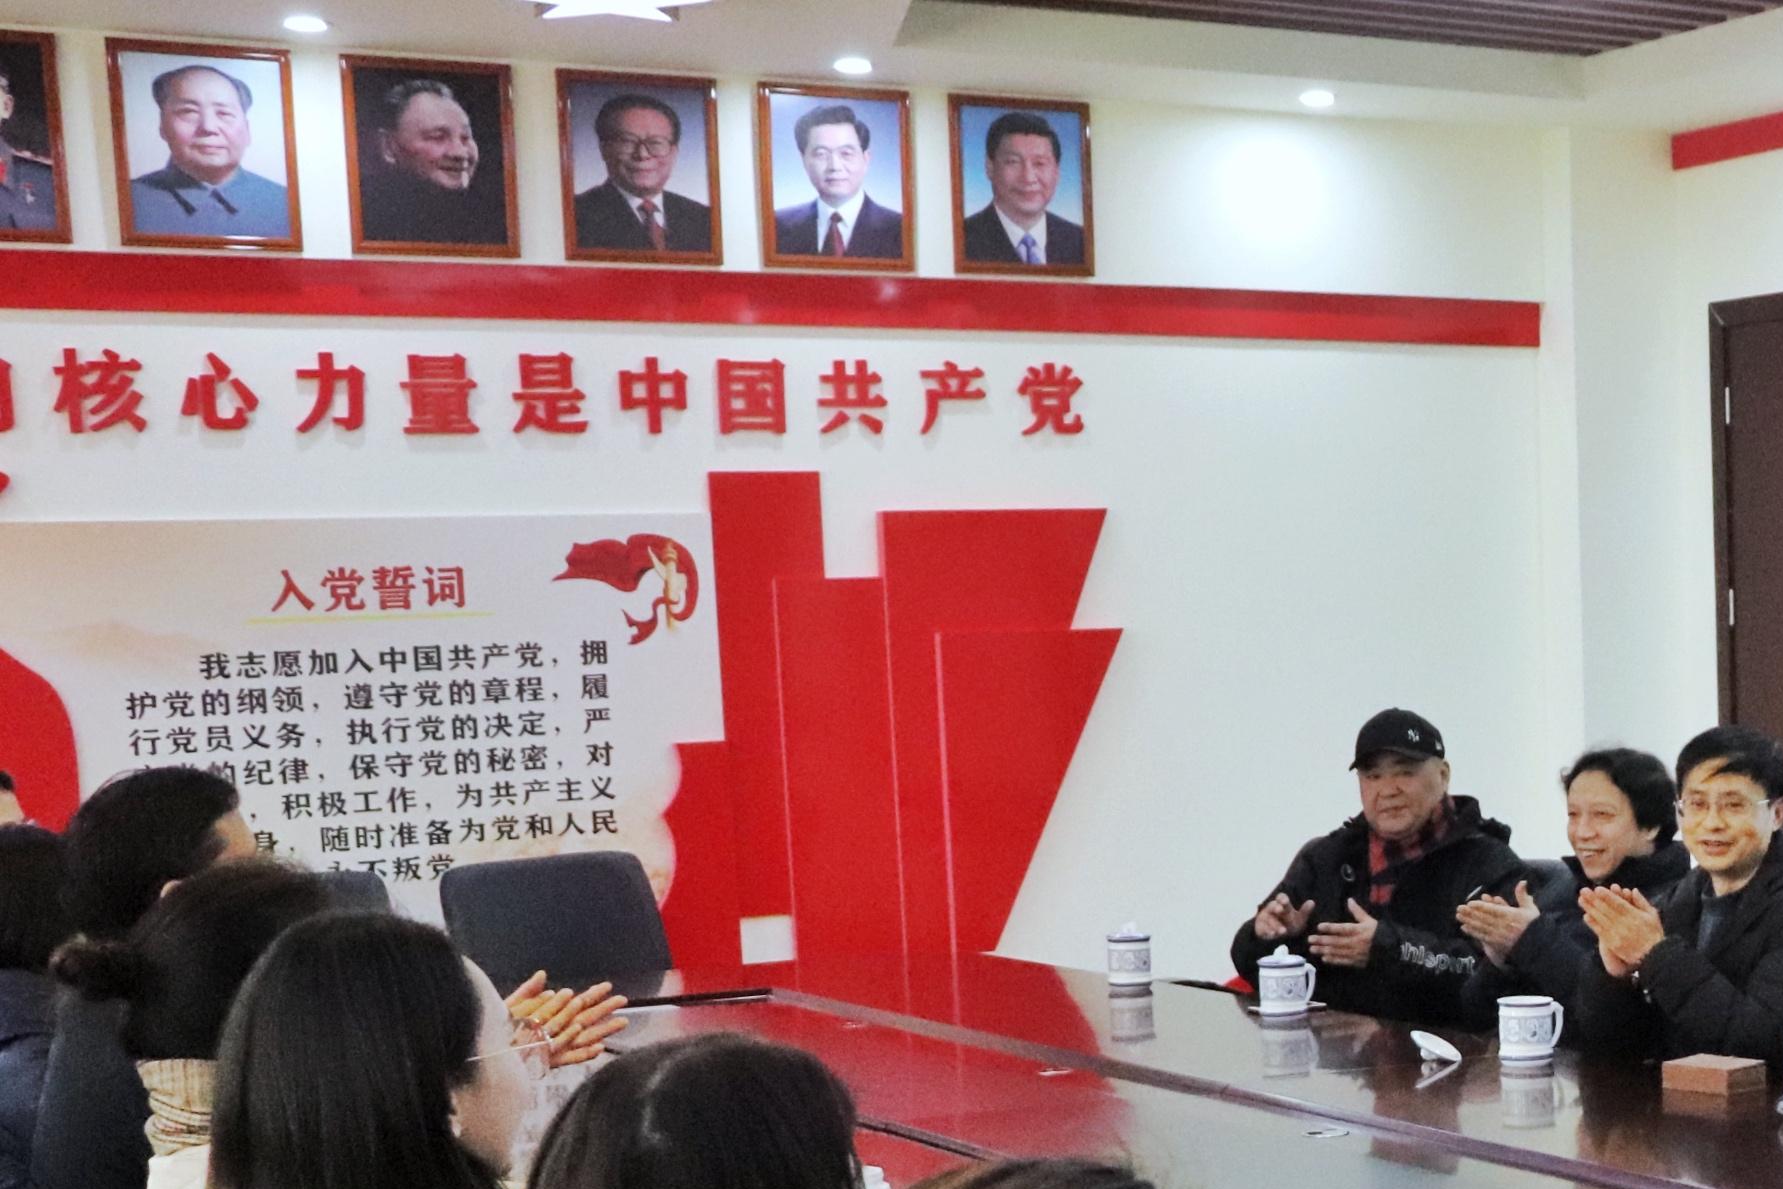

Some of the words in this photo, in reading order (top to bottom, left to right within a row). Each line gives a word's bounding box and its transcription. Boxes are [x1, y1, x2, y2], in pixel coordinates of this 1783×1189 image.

[0, 348, 1084, 436] 核心力量是中国共产党
[271, 565, 466, 612] 入党誓词
[200, 640, 608, 681] 我志愿加入中国共产党，拥
[126, 674, 610, 720] 护党的纲领，遵守党的章程，履
[128, 707, 612, 756] 行党员义务，执行党的决定，严
